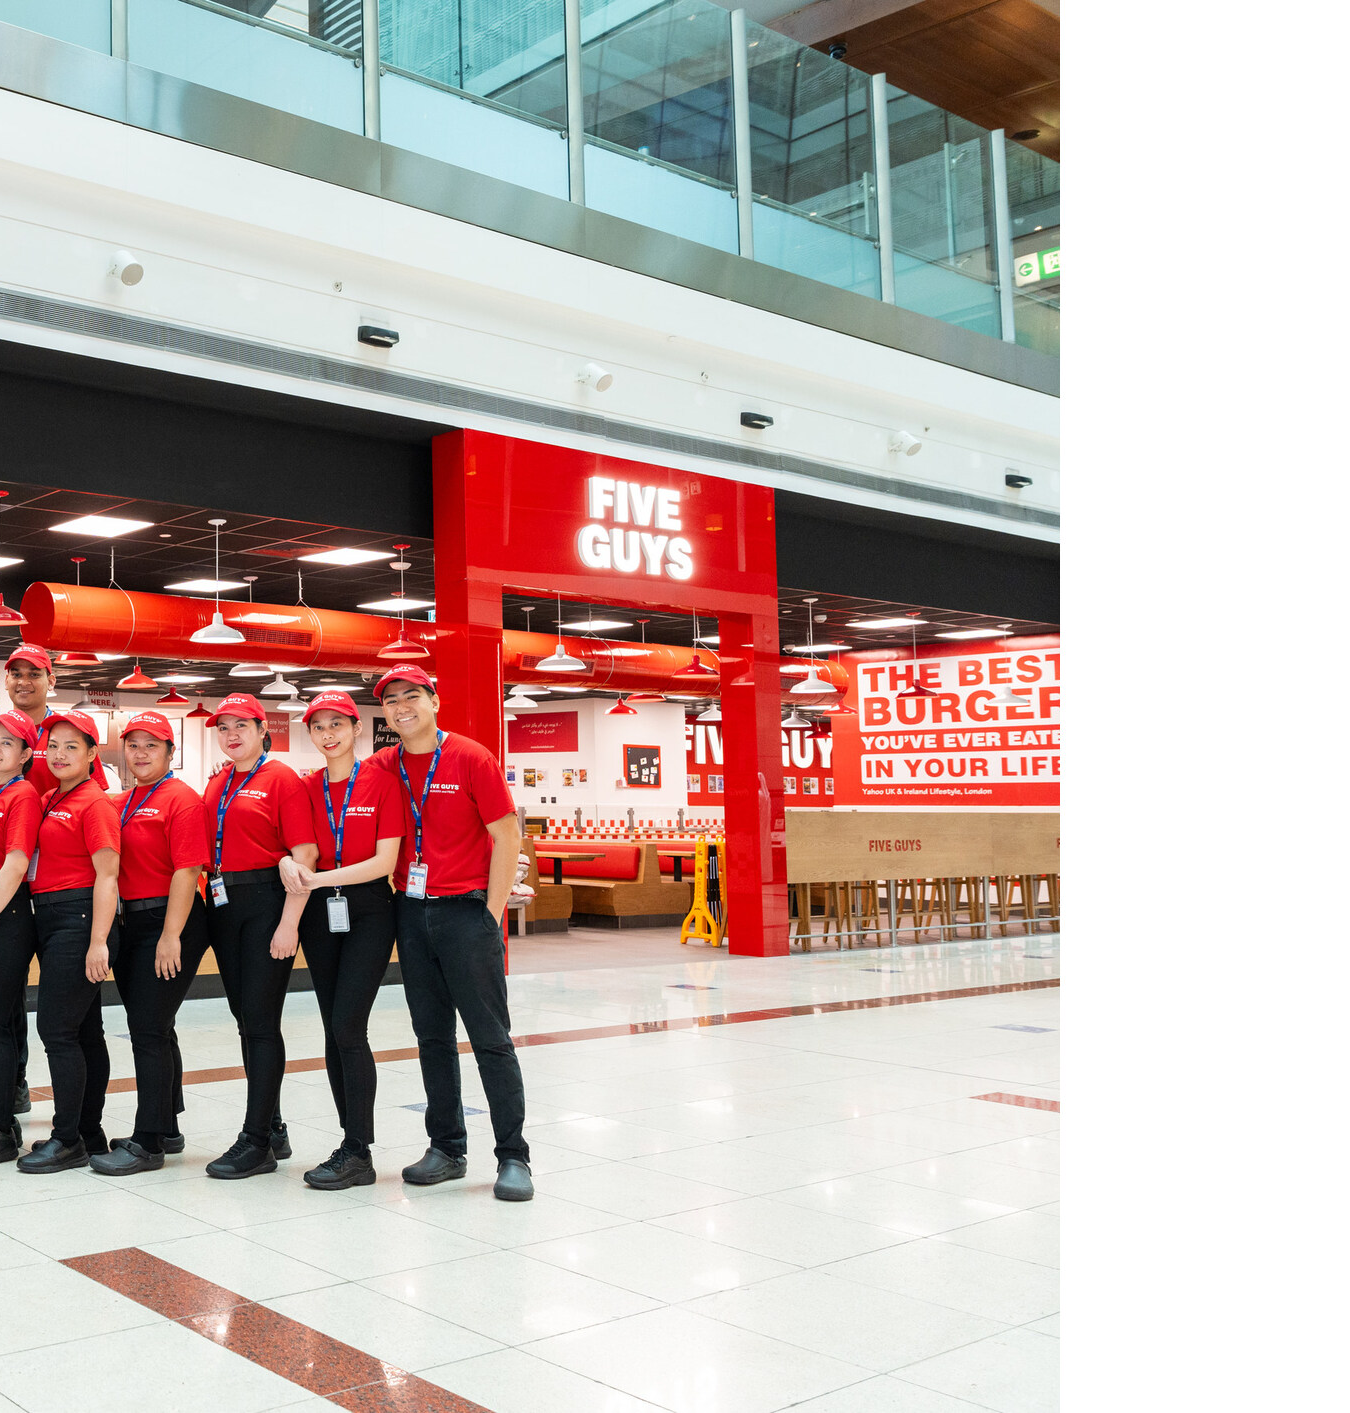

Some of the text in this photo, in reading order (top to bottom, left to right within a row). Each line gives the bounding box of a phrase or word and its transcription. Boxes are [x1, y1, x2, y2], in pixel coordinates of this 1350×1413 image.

[588, 476, 682, 531] FIVE
[577, 523, 693, 580] GUYS
[862, 662, 942, 692] THE
[374, 734, 403, 744] for Lunc
[861, 733, 937, 750] YOU'VE
[943, 731, 1001, 748] EVER
[865, 759, 894, 778] IN
[904, 758, 989, 778] YOUR
[441, 783, 460, 791] GUYS
[868, 839, 922, 852] FIVE GUYS
